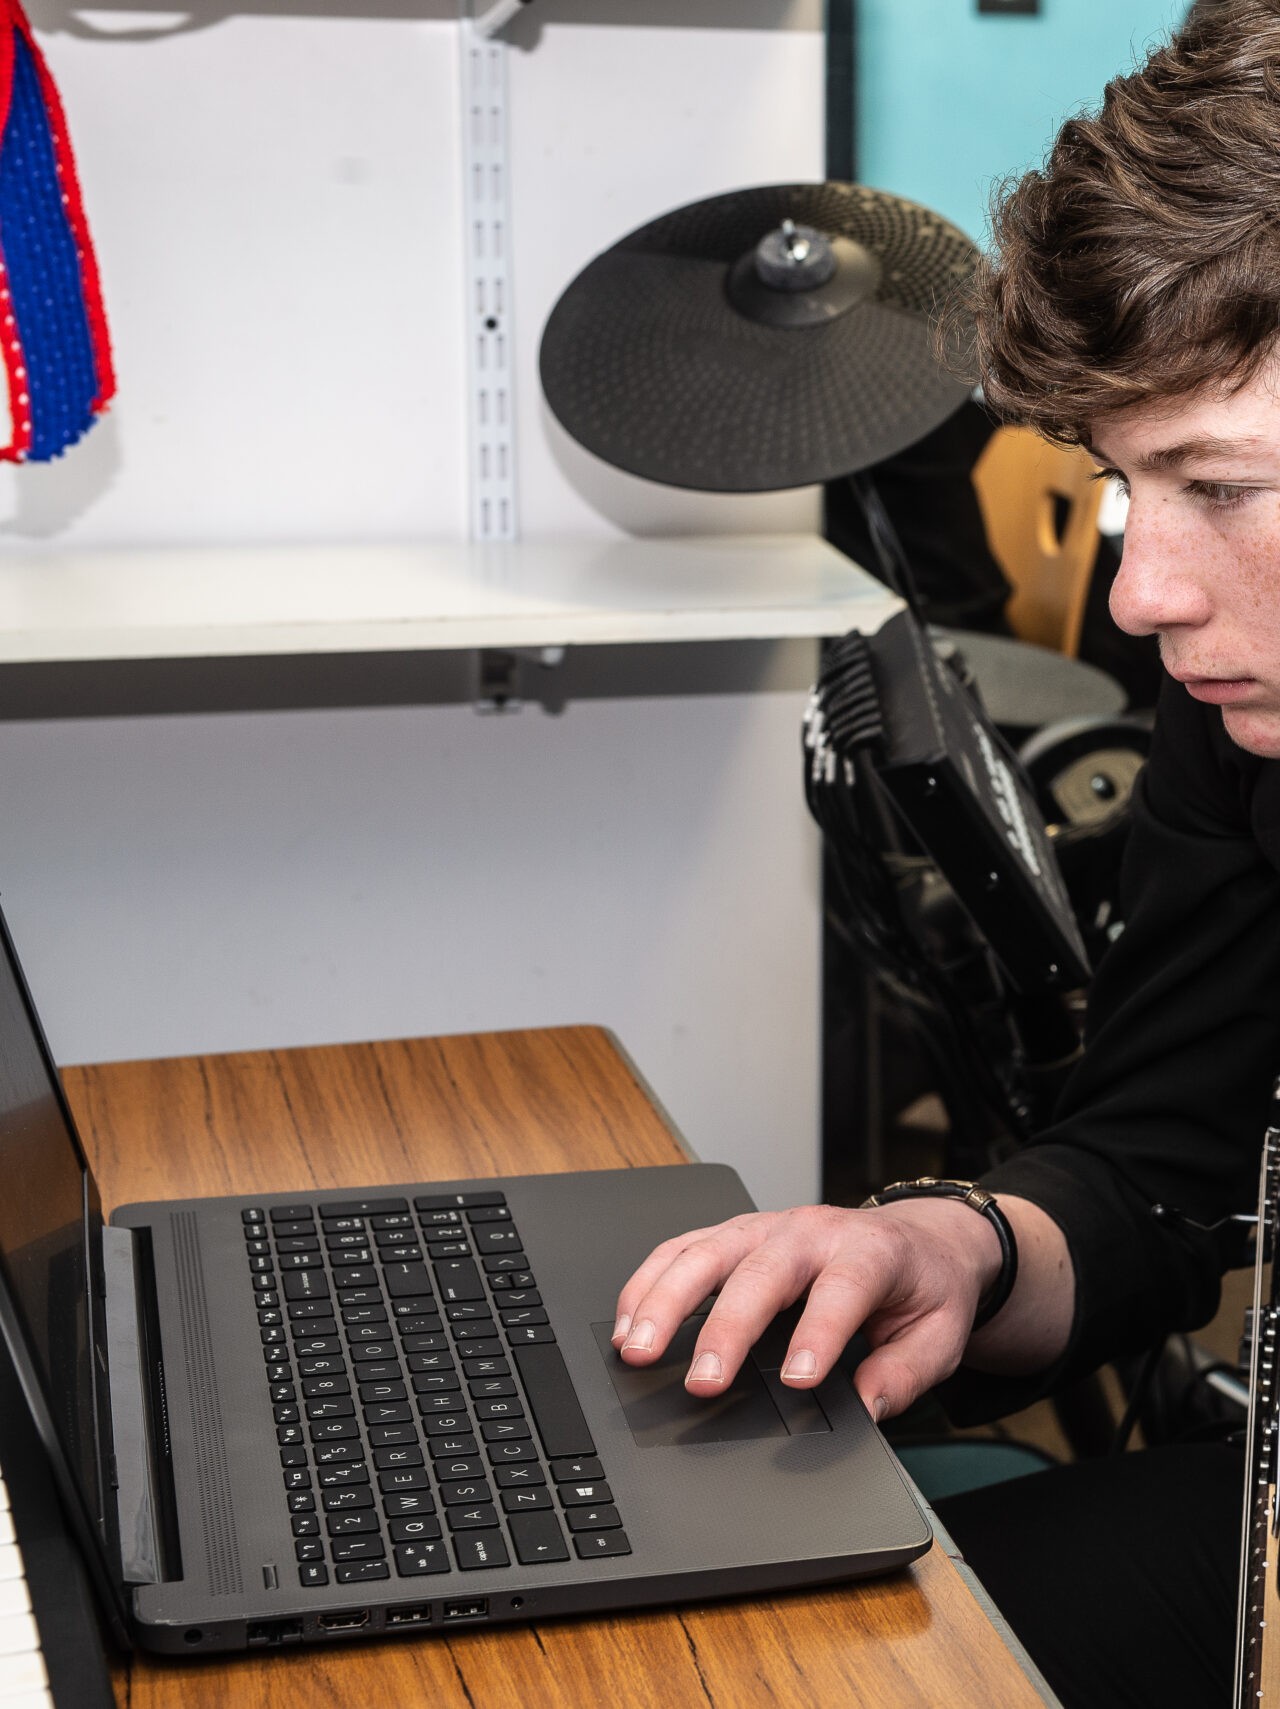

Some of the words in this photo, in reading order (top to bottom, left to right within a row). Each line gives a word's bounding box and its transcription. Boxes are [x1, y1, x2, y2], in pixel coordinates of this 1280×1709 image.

[365, 1346, 382, 1354] O
[422, 1356, 439, 1365] K
[478, 1362, 495, 1370] M
[374, 1386, 392, 1395] U
[484, 1382, 502, 1390] N
[433, 1397, 450, 1405] H
[490, 1403, 508, 1411] B
[379, 1408, 396, 1416] Y
[438, 1418, 456, 1427] G
[326, 1424, 343, 1432] 6
[497, 1425, 514, 1433] V
[503, 1446, 521, 1455] C
[389, 1452, 407, 1460] R
[451, 1463, 469, 1472] D
[510, 1469, 529, 1478] X
[394, 1474, 413, 1483] E
[456, 1487, 475, 1495] S
[517, 1493, 537, 1502] Z
[399, 1497, 419, 1509] W
[463, 1510, 482, 1519] A
[405, 1522, 424, 1532] Q
[478, 1550, 488, 1561] caps
